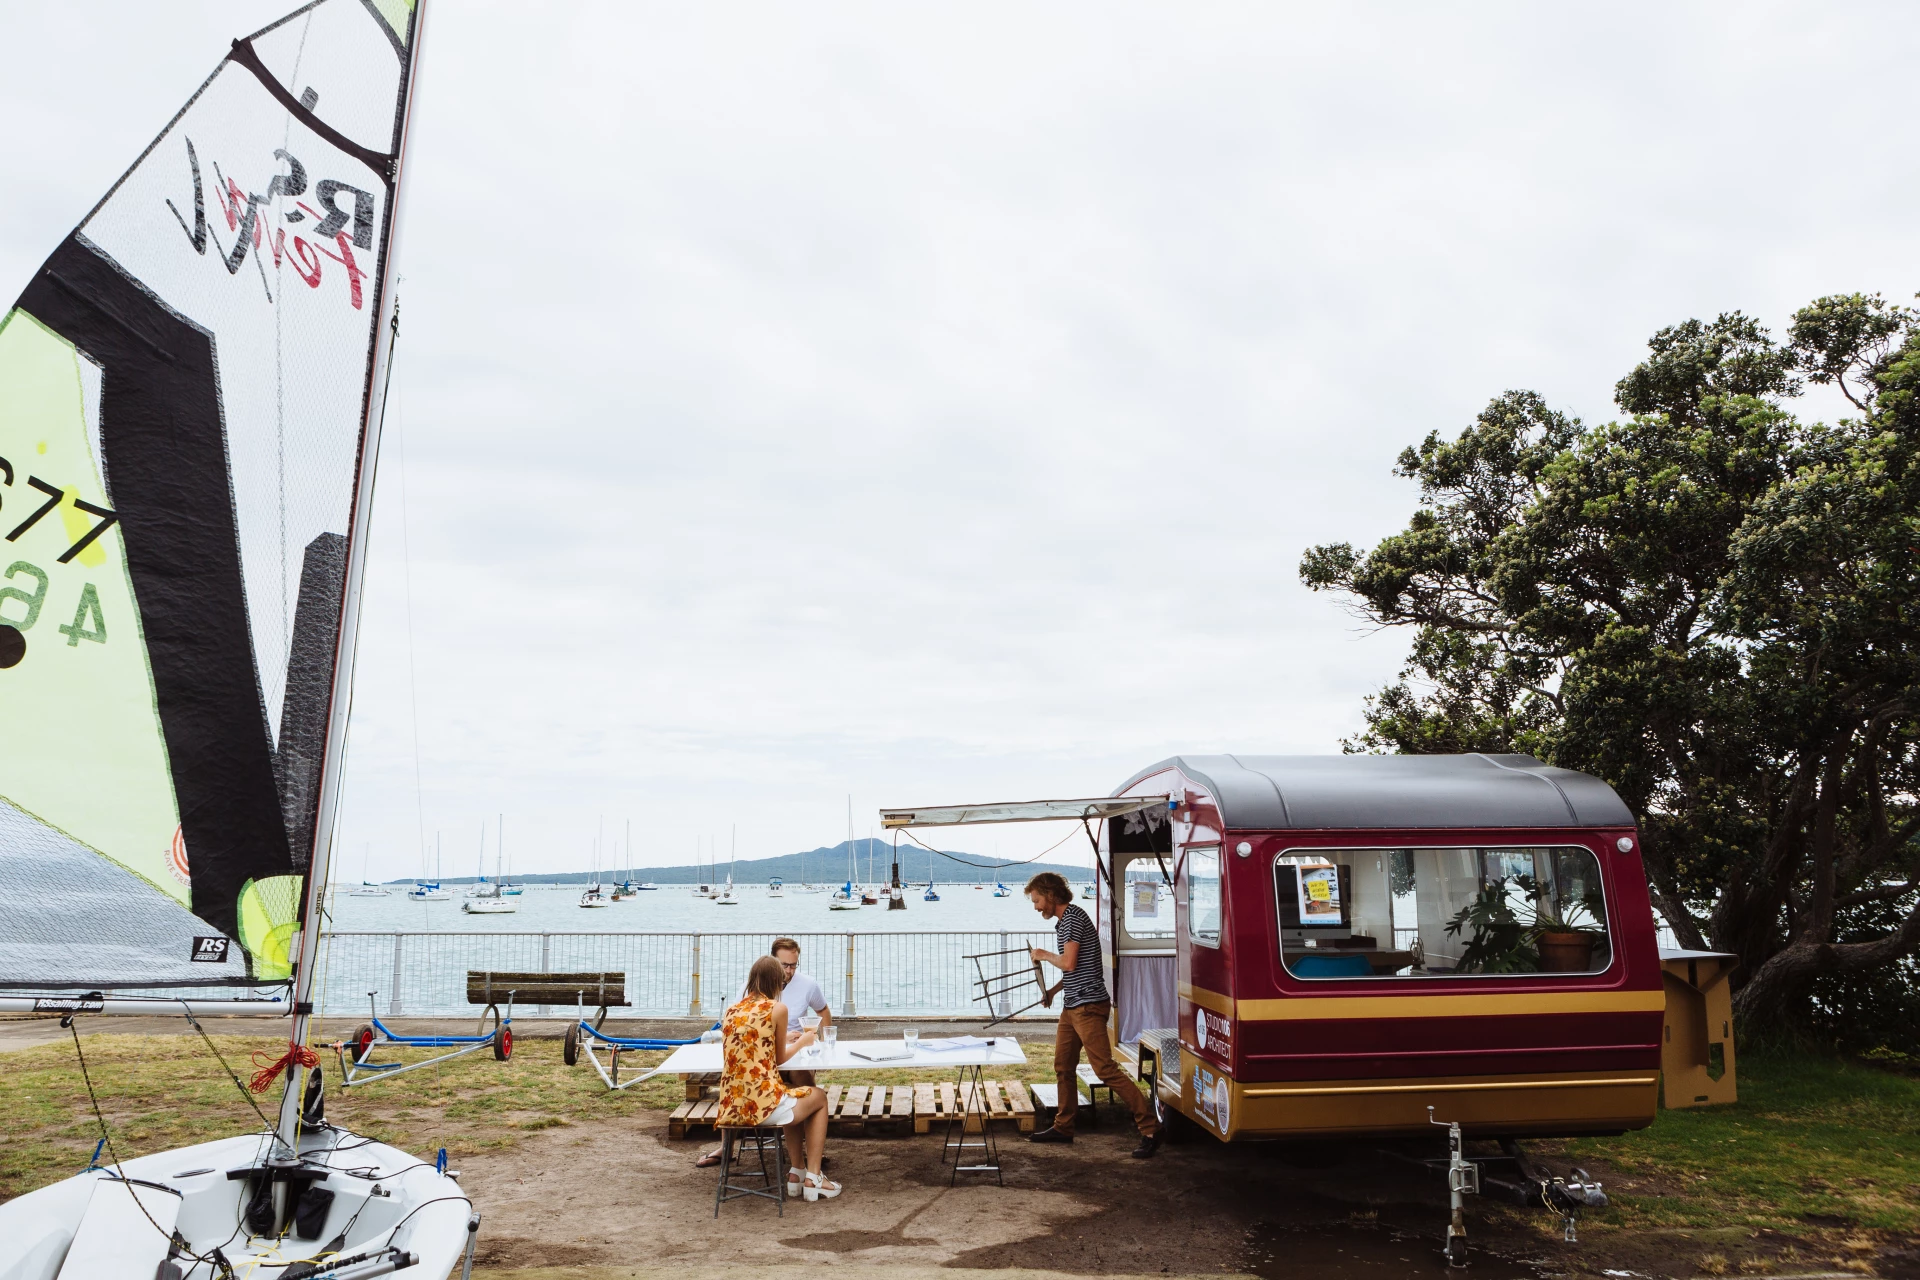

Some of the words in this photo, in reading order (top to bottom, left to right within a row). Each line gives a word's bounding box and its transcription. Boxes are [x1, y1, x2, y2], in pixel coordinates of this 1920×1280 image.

[164, 849, 175, 873] RAYE
[199, 938, 227, 952] RS
[36, 998, 104, 1010] RSsailing.com
[1207, 1034, 1231, 1060] ARCHITECT
